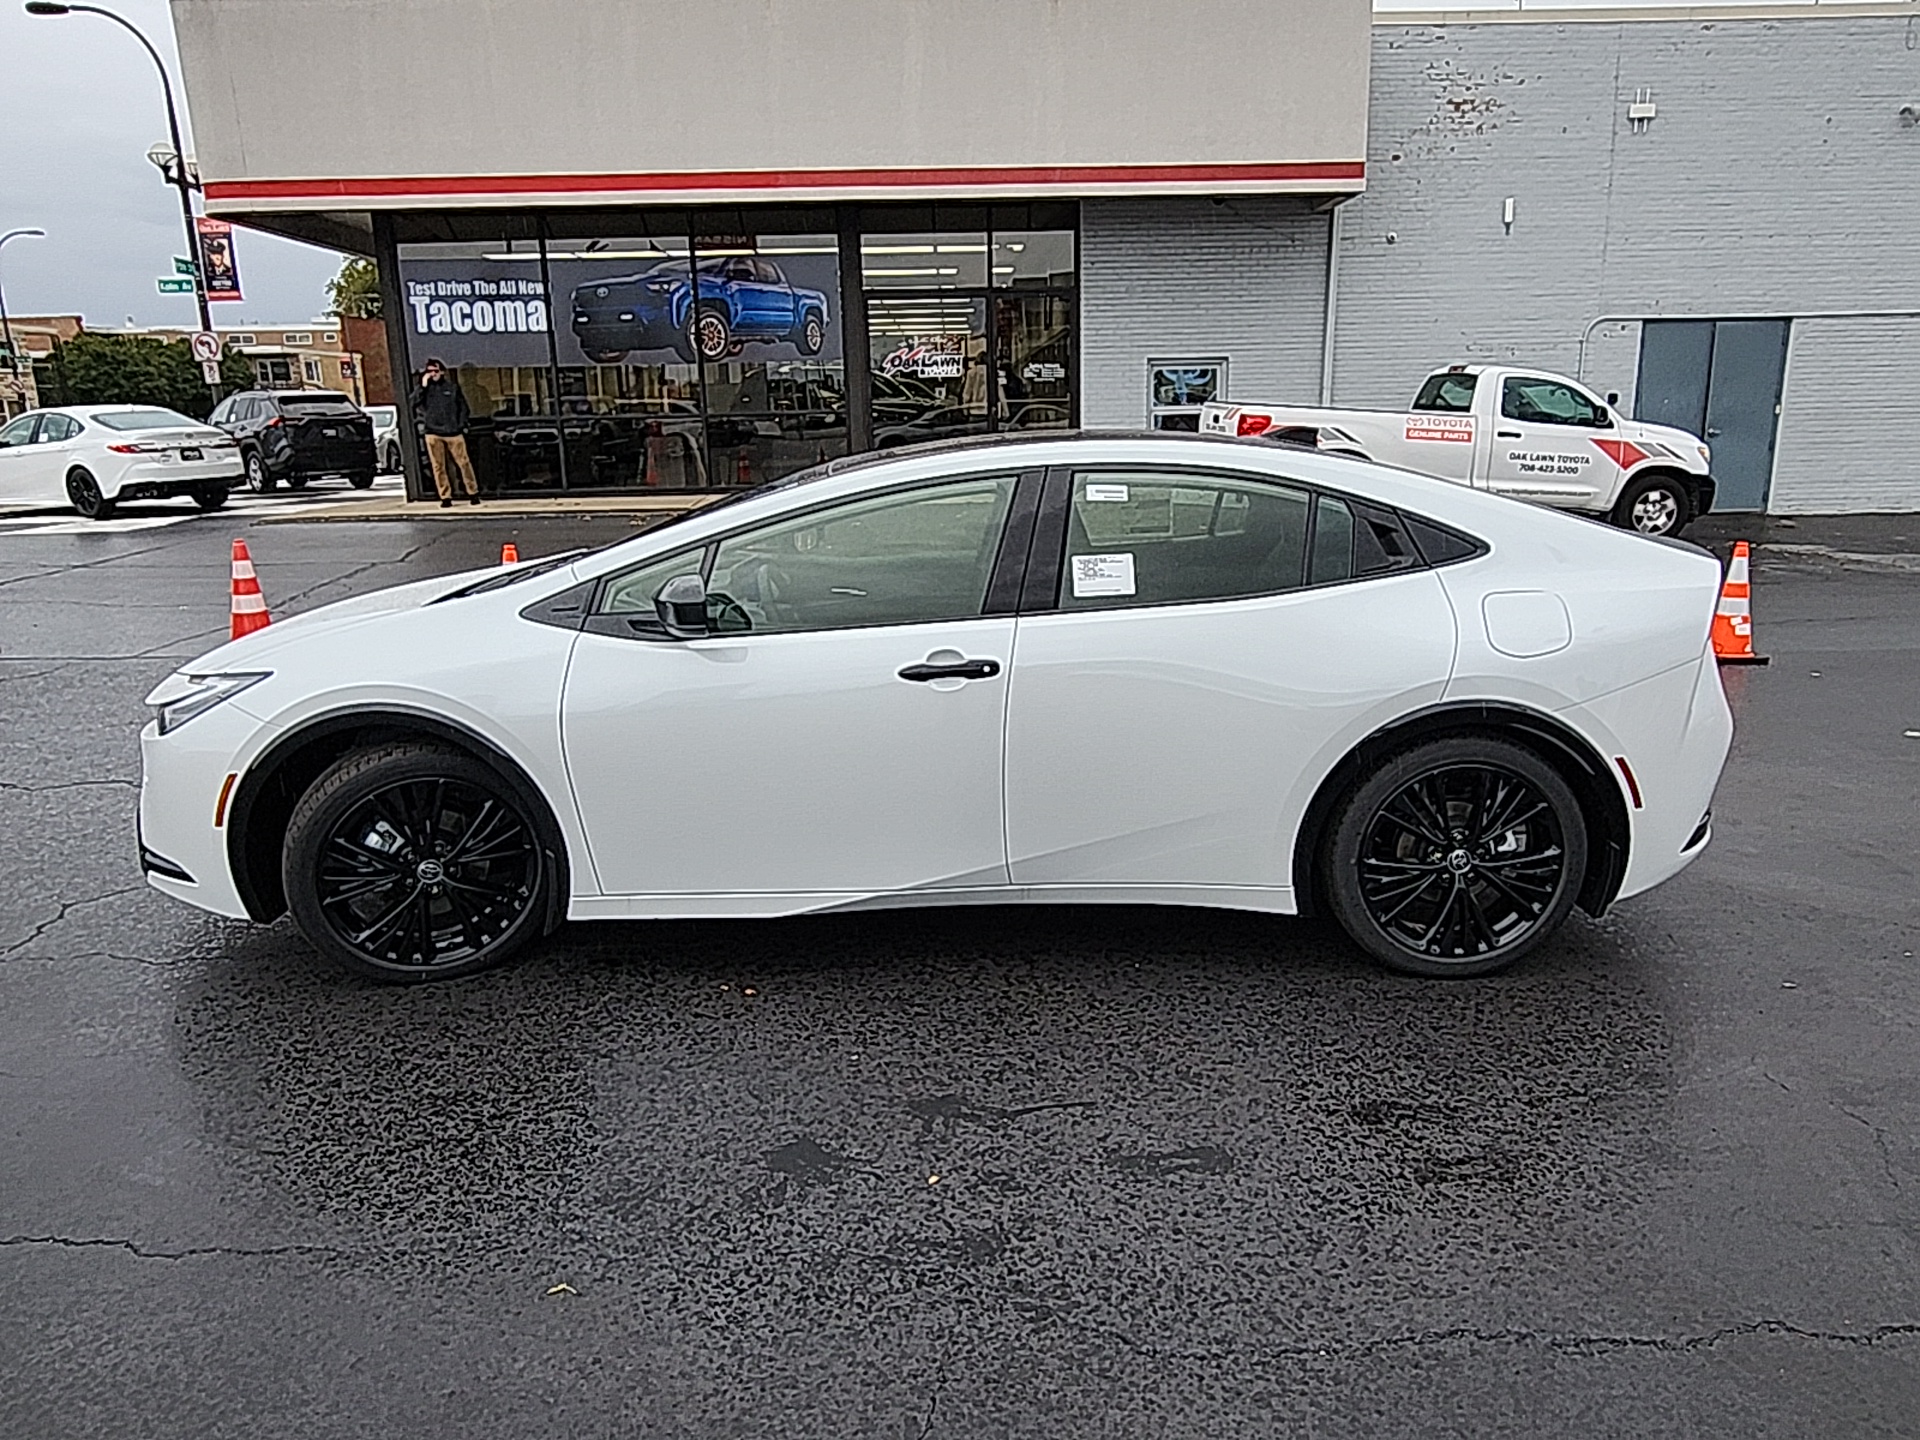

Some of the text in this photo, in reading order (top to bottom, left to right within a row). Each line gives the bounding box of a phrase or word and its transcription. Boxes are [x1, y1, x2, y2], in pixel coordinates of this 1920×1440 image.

[407, 279, 545, 296] Test Drive The All New
[408, 296, 548, 333] Tacoma
[1425, 417, 1473, 429] TOYOTA
[1408, 429, 1469, 441] GENUINE PARTS
[1509, 452, 1591, 465] OAK LAWN TOYOTA
[1519, 463, 1579, 475] 708-423-5200
